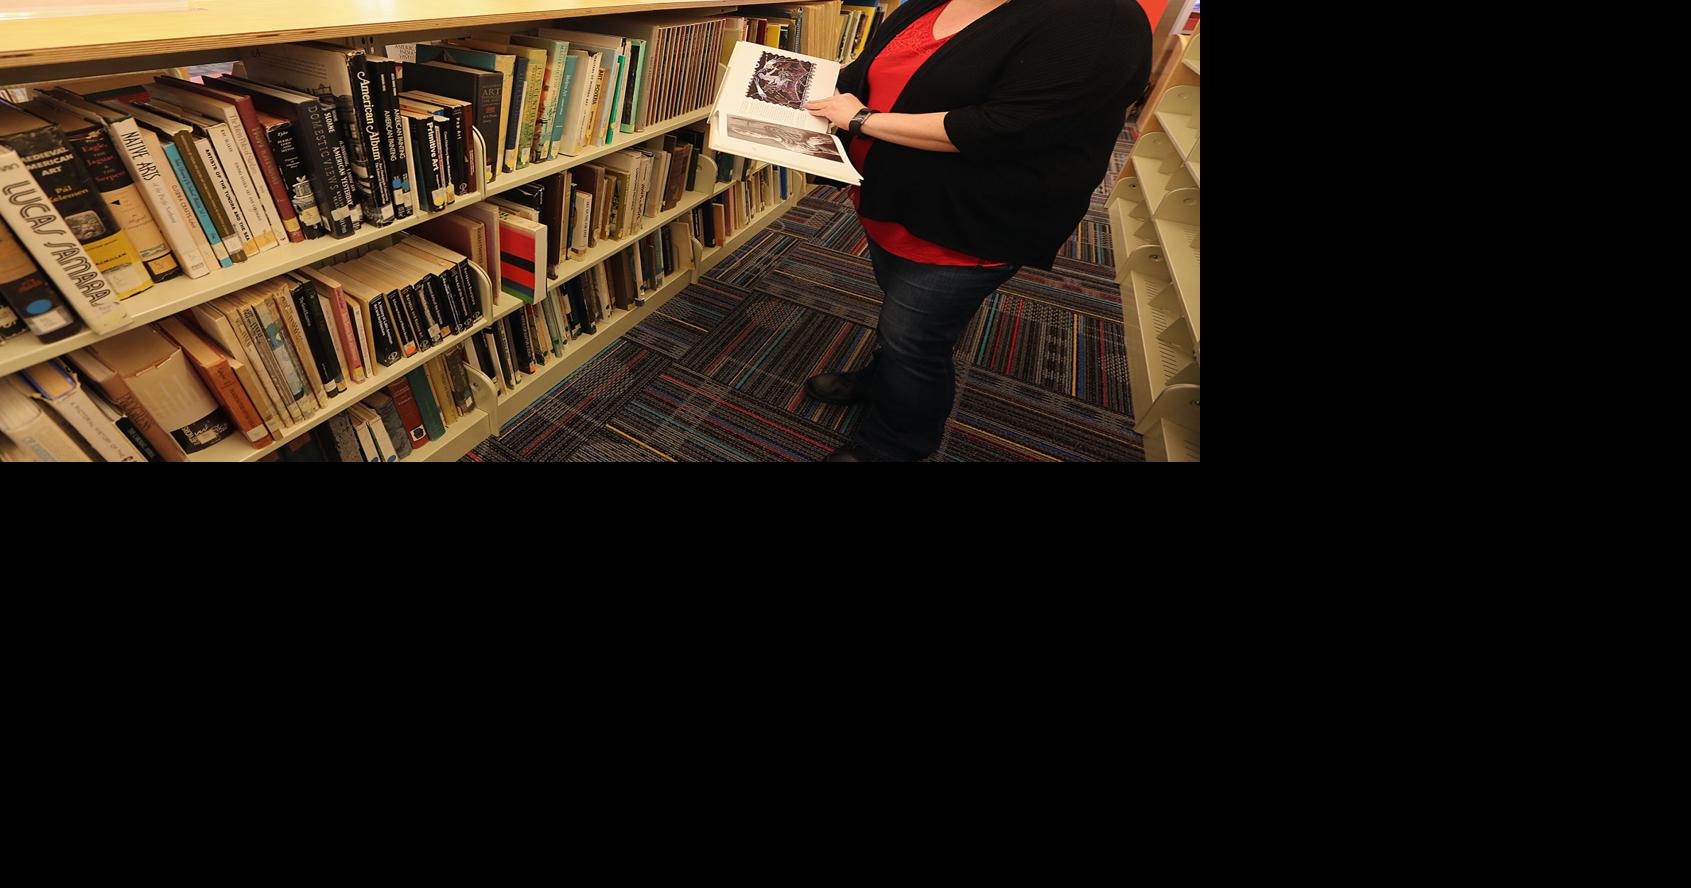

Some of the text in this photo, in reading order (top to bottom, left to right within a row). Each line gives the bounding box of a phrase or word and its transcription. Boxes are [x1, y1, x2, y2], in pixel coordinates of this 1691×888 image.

[356, 72, 381, 161] American Album
[482, 87, 501, 98] ART
[324, 112, 336, 133] SLOANE
[383, 110, 397, 162] AMERICAN PAINTING
[393, 108, 404, 135] AMERICAN
[27, 154, 74, 170] MERICAN
[41, 166, 62, 177] ART
[121, 131, 150, 161] NATIVE
[136, 161, 161, 181] ARTS
[308, 106, 331, 160] DOMESTIC
[321, 160, 339, 190] VIEWS
[397, 134, 406, 160] PAINTING
[427, 122, 439, 172] Primitive Art
[205, 149, 218, 170] ARTISTS
[215, 171, 222, 180] OF
[219, 180, 227, 191] THE
[225, 190, 236, 212] TUNDRA
[233, 211, 241, 223] AND
[238, 221, 246, 231] THE
[333, 146, 346, 178] AMERICAN
[340, 175, 356, 206] YESTERDAY
[2, 179, 67, 236] LUCAS
